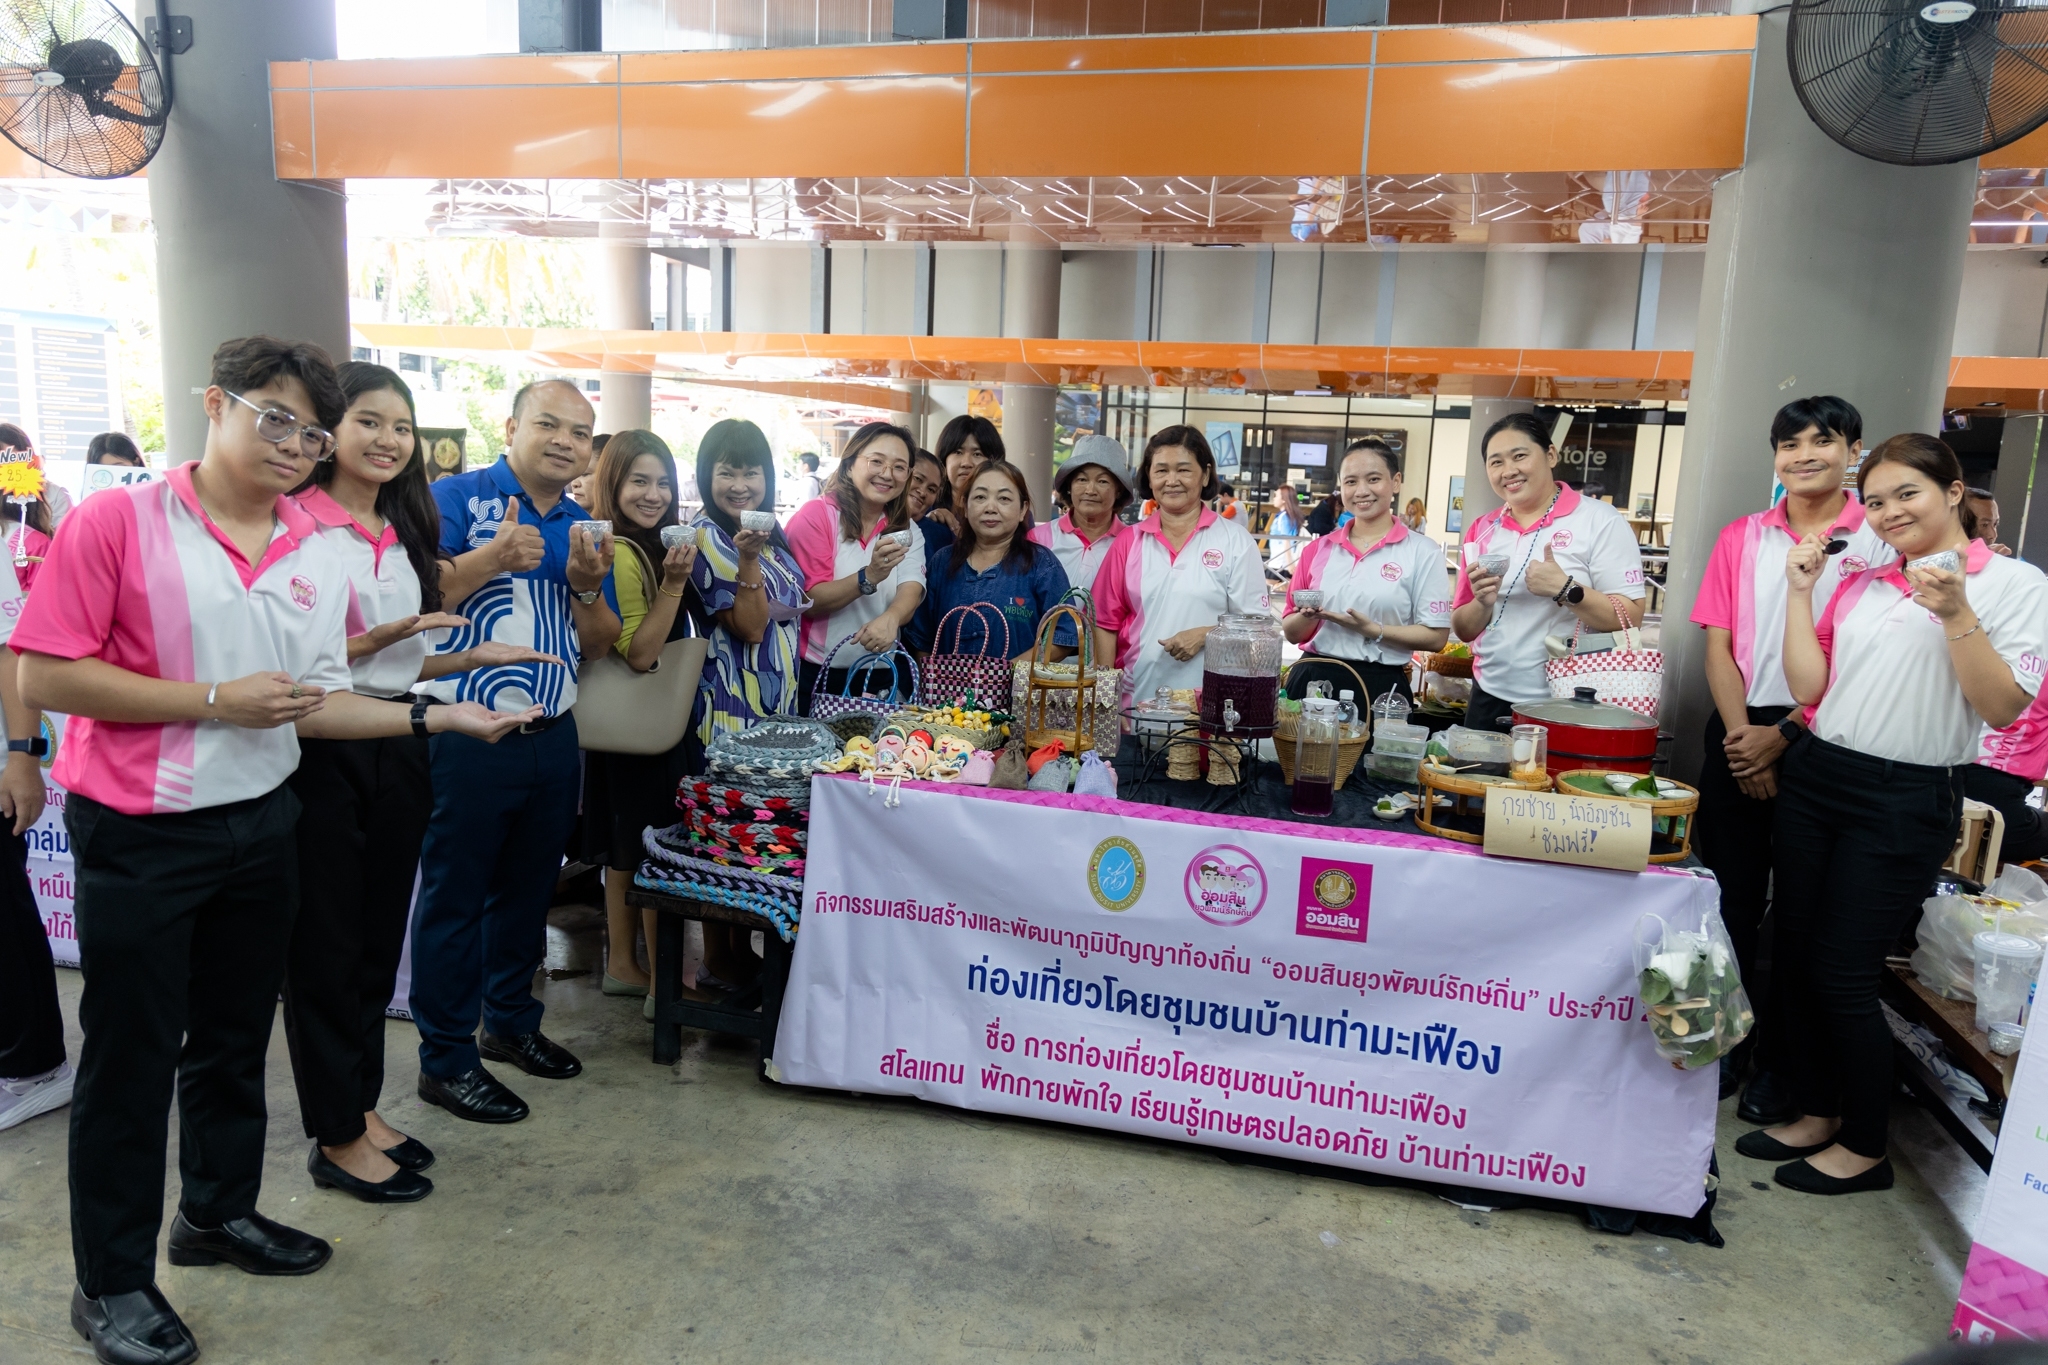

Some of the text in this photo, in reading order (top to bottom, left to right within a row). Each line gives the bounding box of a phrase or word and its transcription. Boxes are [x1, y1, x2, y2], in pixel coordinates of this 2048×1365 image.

[0, 448, 32, 463] New!
[1541, 827, 1598, 854] ชิมฟรี!
[1090, 874, 1142, 909] SUAN DUSIT UNIVERSITY
[1305, 912, 1360, 929] ออมสิน
[815, 891, 1252, 976] กิจกรรมเสริมสร้างและพัฒนาภูมิปัญญาท้องถิ่น
[1547, 992, 1635, 1022] ประจำปี
[968, 954, 1502, 1075] ท่องเที่ยวโดยชุมชนบ้านท่ามะเฟือง
[986, 1016, 1467, 1130] ชื่อ การท่องเที่ยวโดยชุมชนบ้านท่ามะเฟือง
[880, 1048, 1587, 1188] สโลแกน พักกายพักใจ เรียนรู้เกษตรปลอดภัย บ้านท่ามะเฟือง
